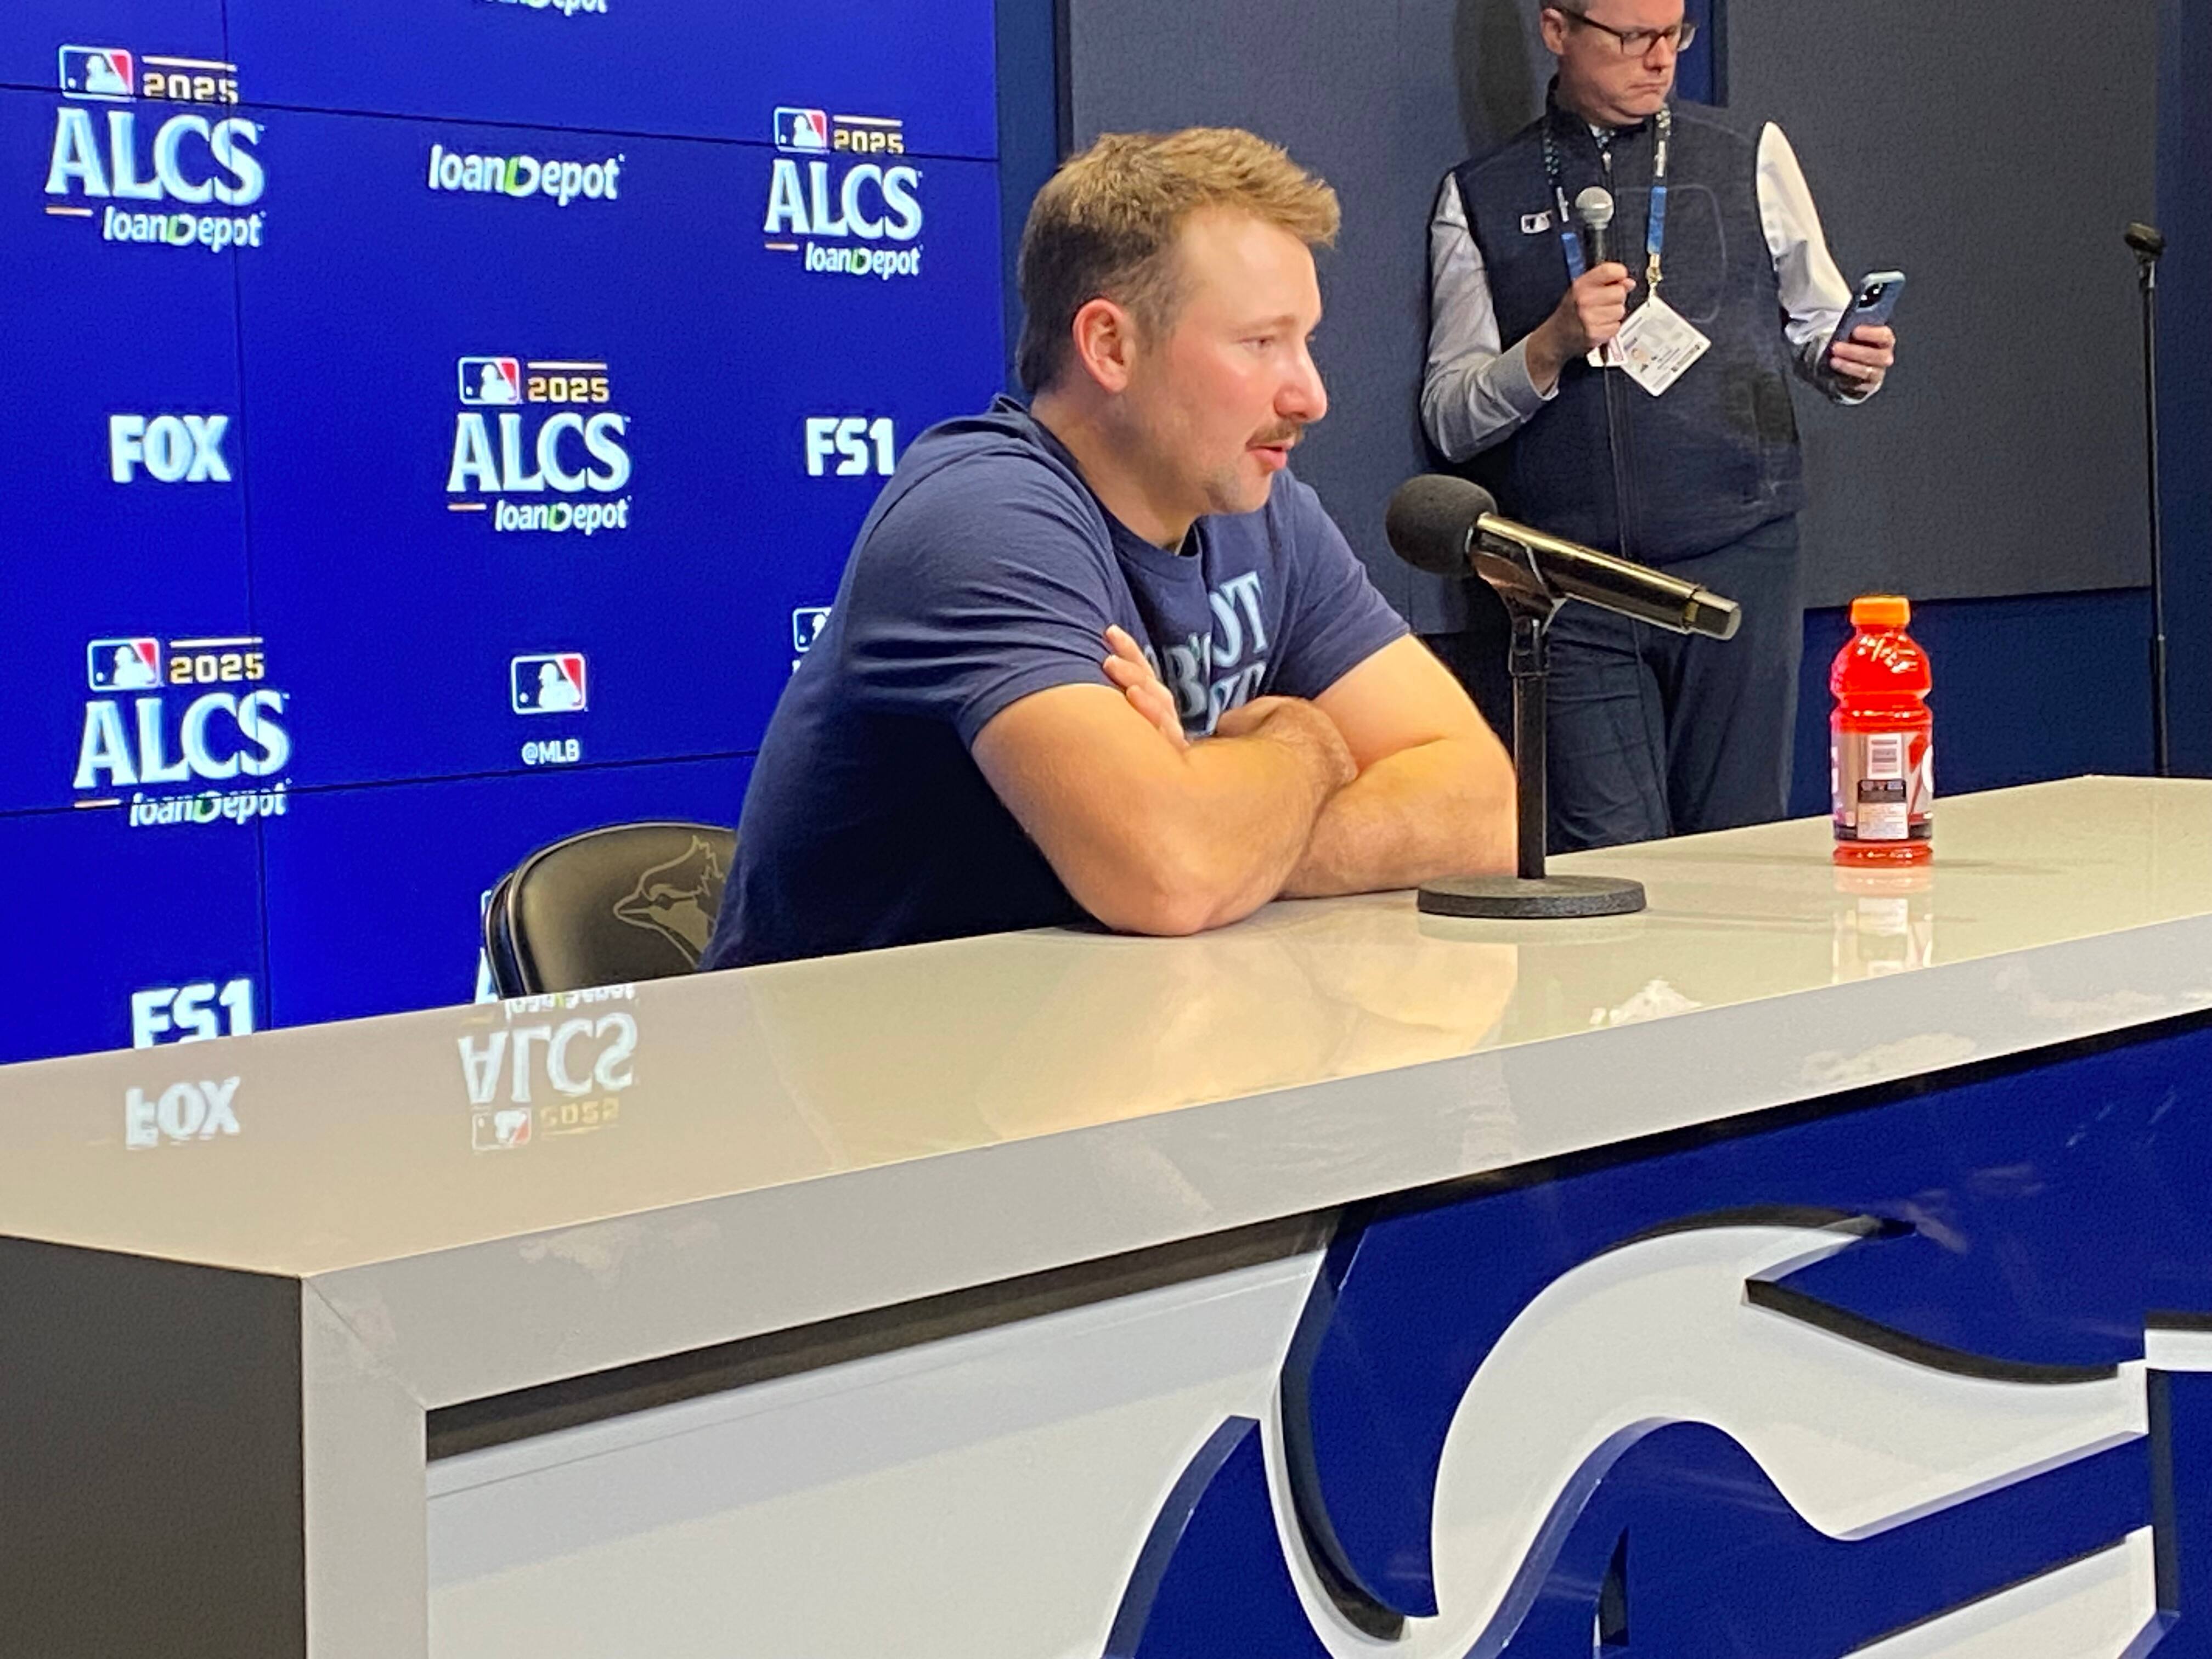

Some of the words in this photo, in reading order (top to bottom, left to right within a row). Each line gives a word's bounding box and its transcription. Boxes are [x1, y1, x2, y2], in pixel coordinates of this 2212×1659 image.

[143, 72, 239, 104] 2025
[45, 108, 265, 206] ALCS
[833, 129, 904, 154] 2025
[428, 144, 619, 206] loanDepot
[764, 159, 923, 240] ALCS
[103, 205, 263, 253] loanDepot
[805, 241, 920, 280] loanDepot
[527, 376, 610, 402] 2025
[110, 415, 231, 483] FOX
[447, 413, 631, 492] ALCS
[806, 417, 895, 476] FS1
[495, 498, 628, 535] loanDepot
[170, 653, 265, 684] 2025
[73, 690, 290, 788] ALCS
[521, 738, 580, 765] @MLB
[129, 789, 286, 827] loanDepot
[132, 979, 253, 1049] FS1
